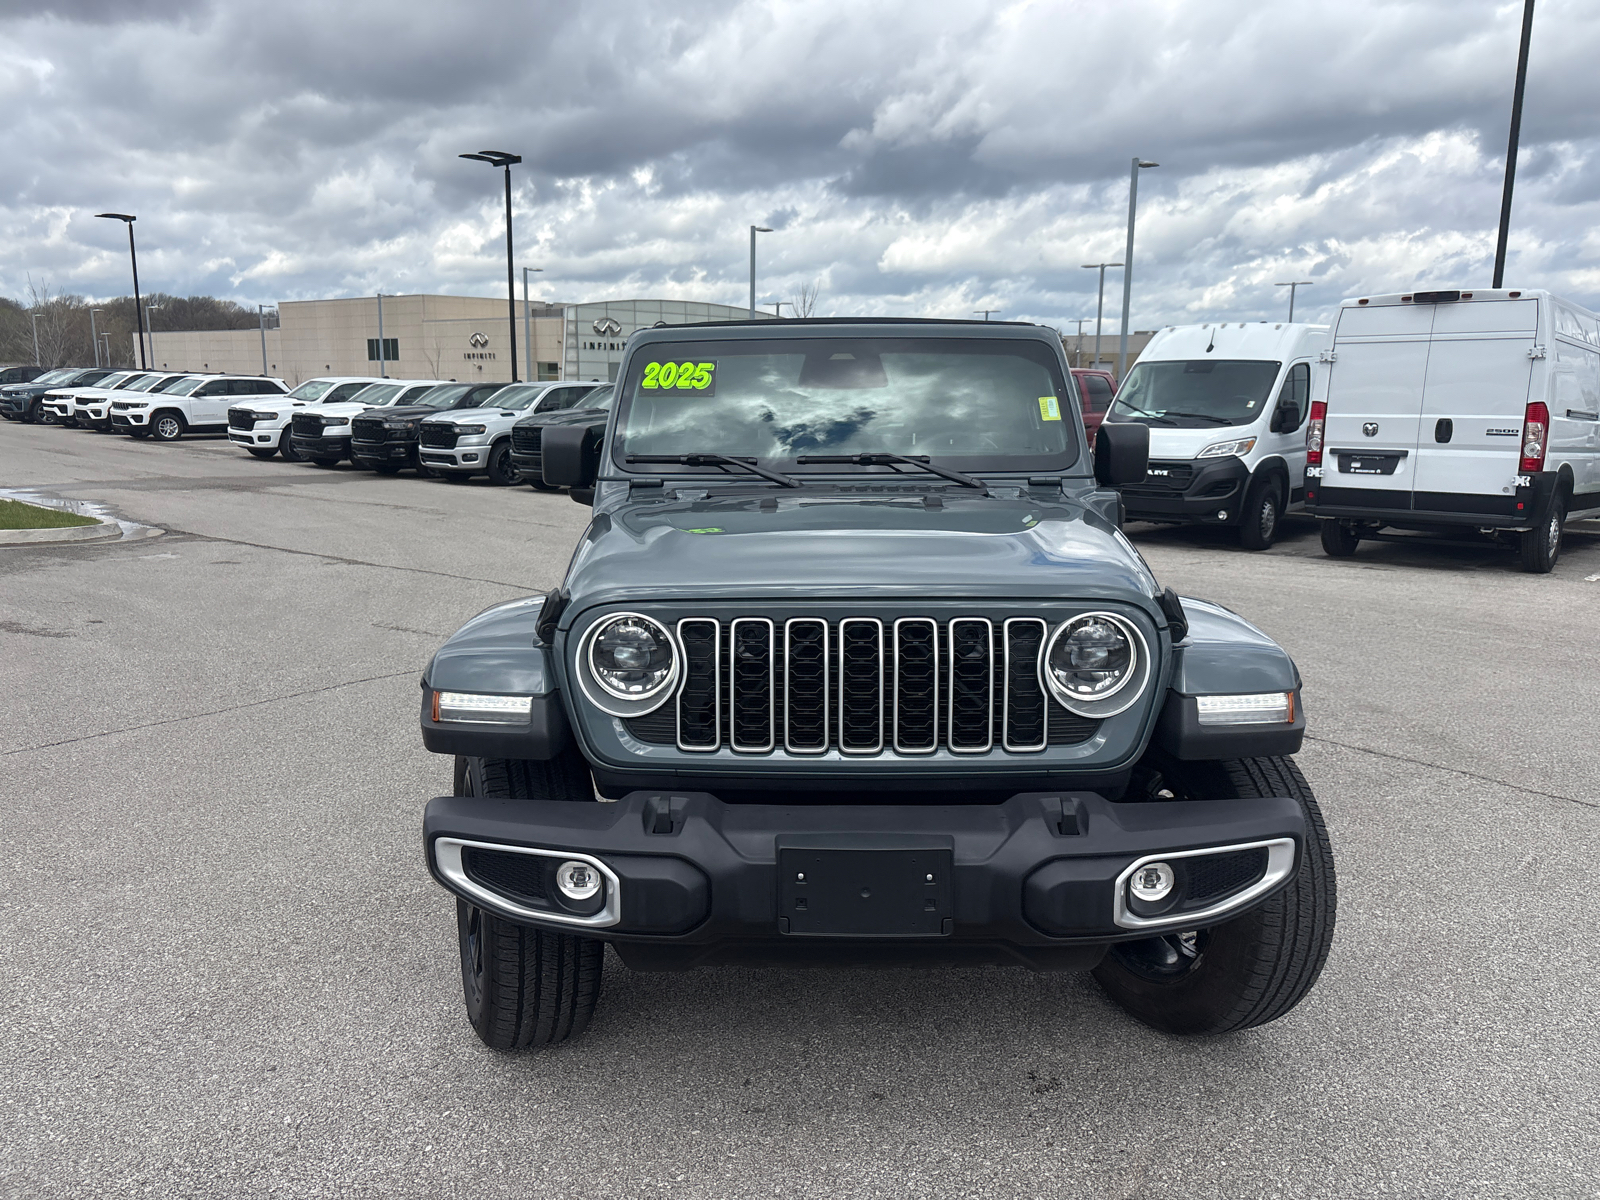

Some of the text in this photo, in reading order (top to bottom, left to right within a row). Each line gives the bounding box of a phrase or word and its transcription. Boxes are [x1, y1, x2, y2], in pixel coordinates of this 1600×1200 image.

[583, 341, 627, 351] INFINIT
[463, 352, 496, 360] INFINITI
[641, 361, 715, 390] 2025
